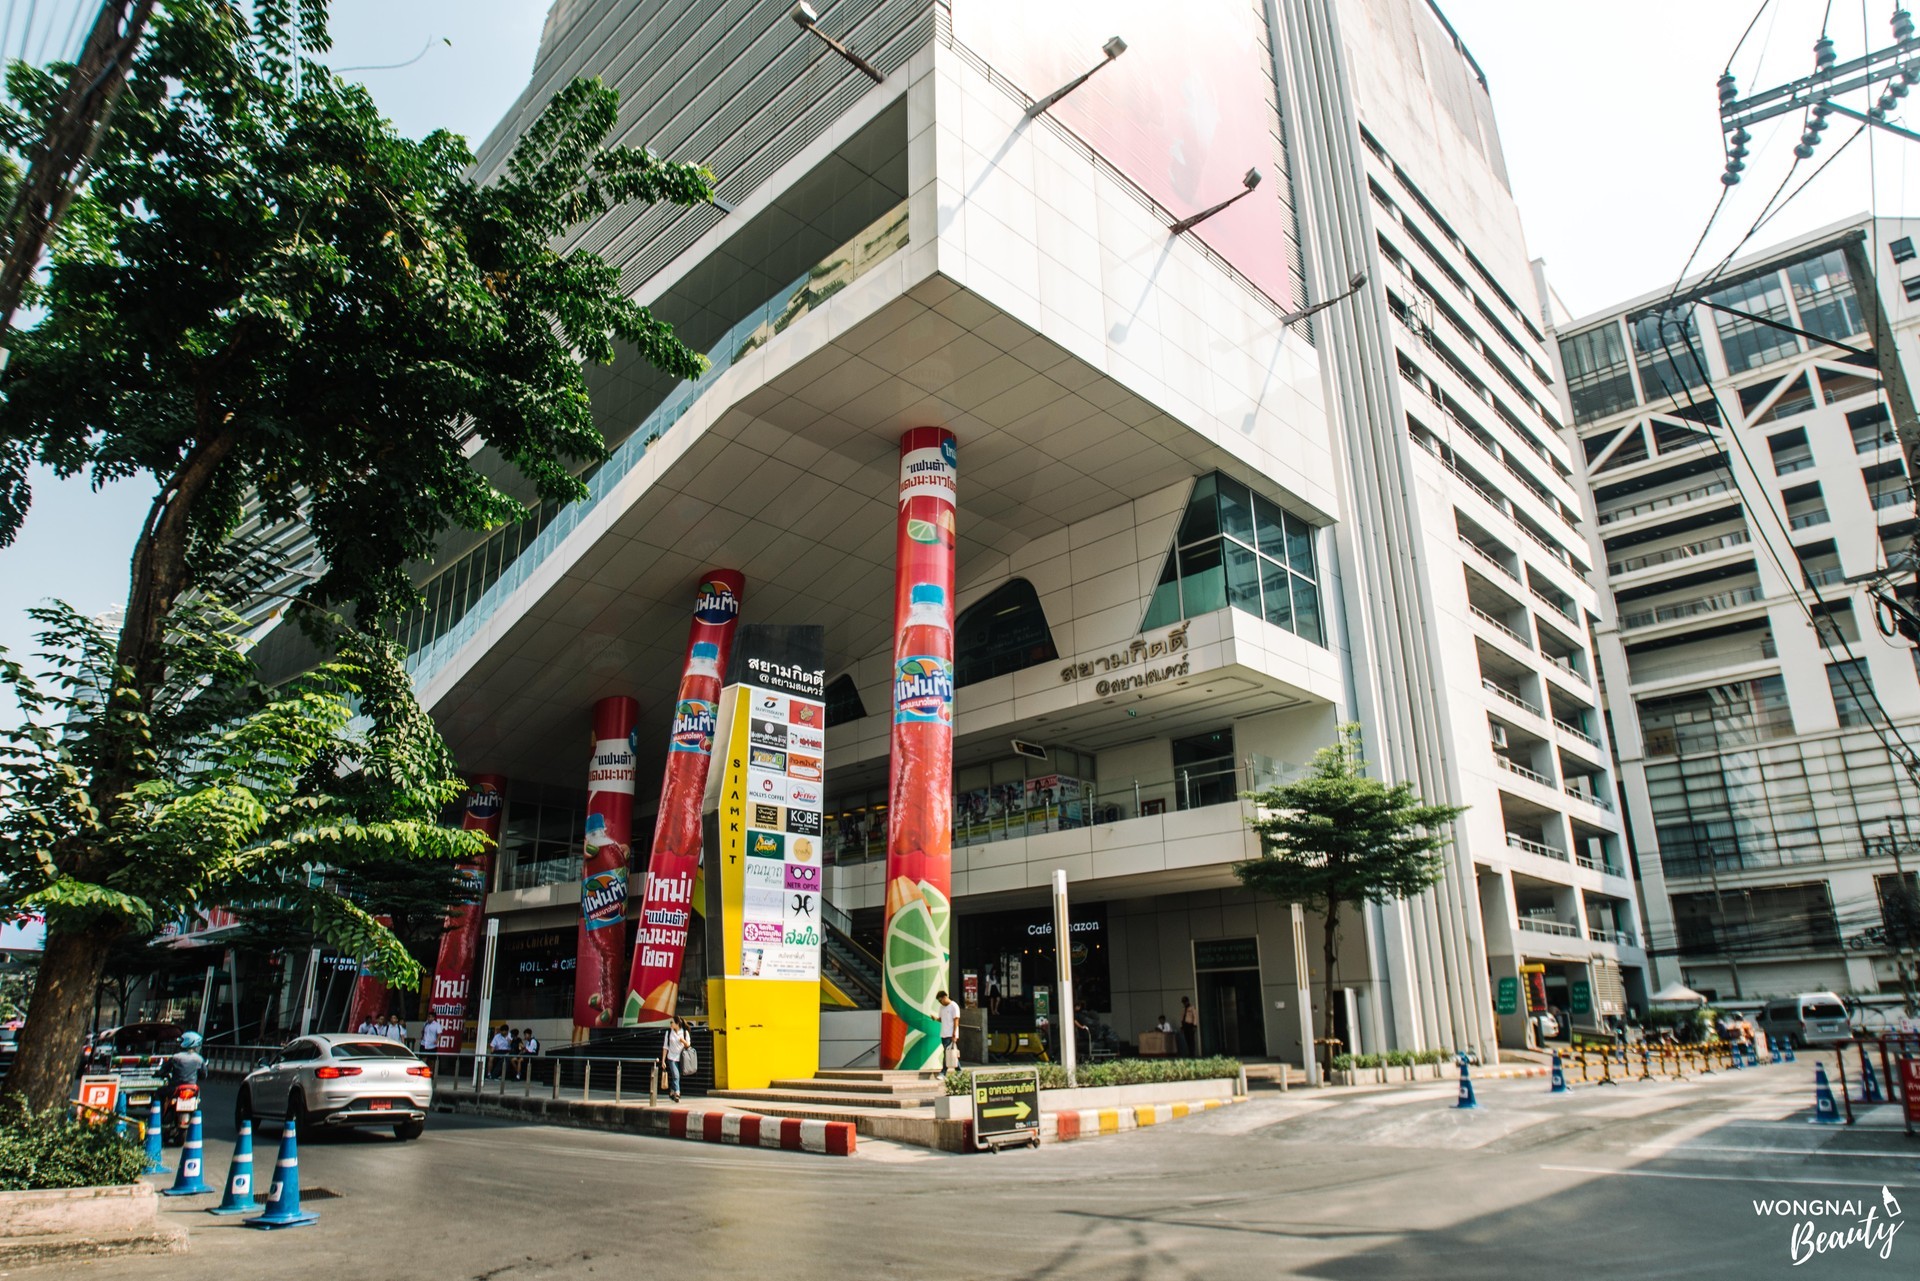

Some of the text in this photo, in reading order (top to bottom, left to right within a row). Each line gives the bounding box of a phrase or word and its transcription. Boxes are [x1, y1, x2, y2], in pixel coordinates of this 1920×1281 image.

[748, 658, 825, 686] สยามกิตติ์
[791, 810, 819, 825] KOBE
[648, 871, 693, 904] ใหม่!
[1028, 923, 1052, 935] Café
[641, 945, 674, 968] โซดา
[434, 974, 470, 999] ใหม่!
[979, 1090, 985, 1101] P
